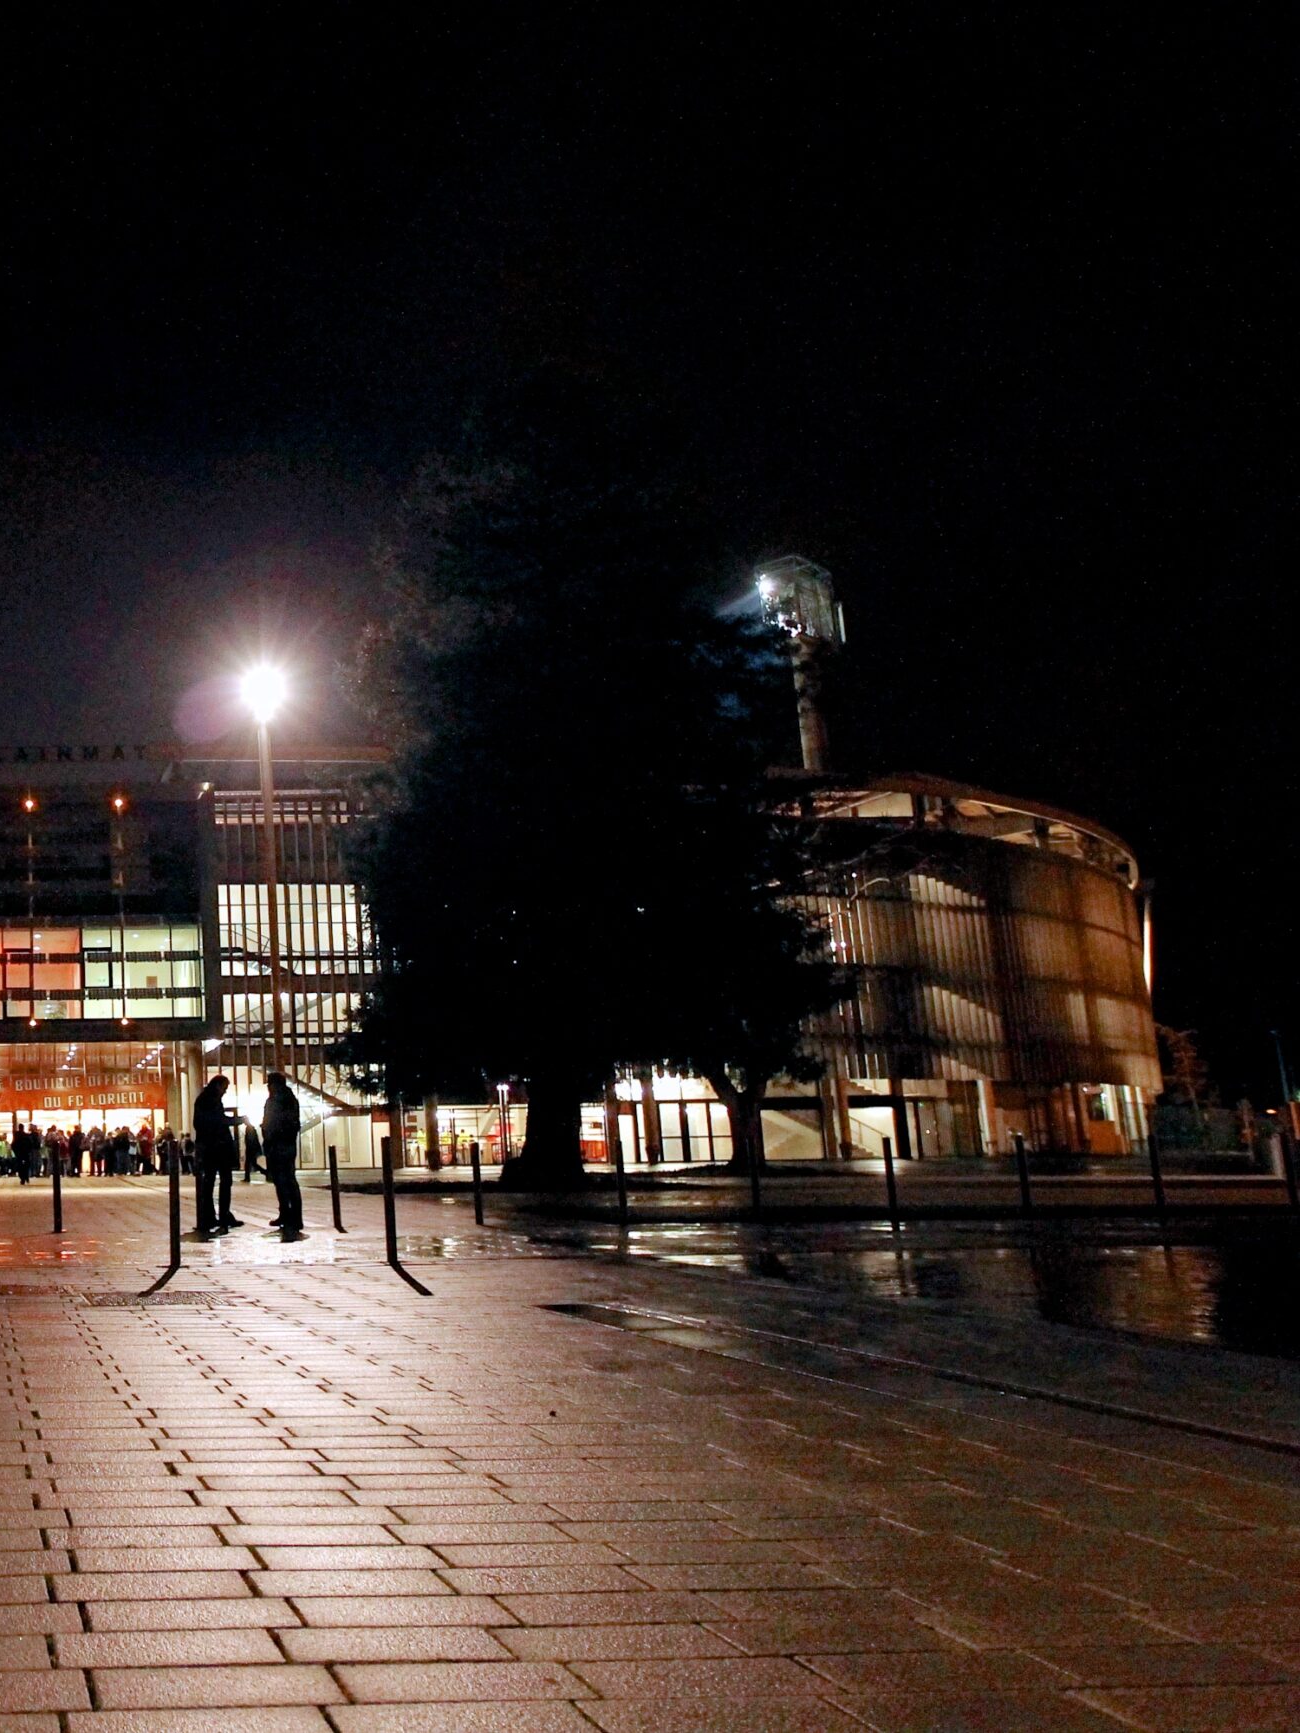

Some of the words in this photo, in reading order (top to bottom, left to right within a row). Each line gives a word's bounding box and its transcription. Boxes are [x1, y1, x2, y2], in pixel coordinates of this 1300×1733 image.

[15, 1077, 81, 1091] BOUTIQUE
[88, 1073, 160, 1087] OFFICIELLE
[44, 1096, 61, 1108] DU
[68, 1094, 84, 1107] FC
[91, 1092, 145, 1105] LORIENT
